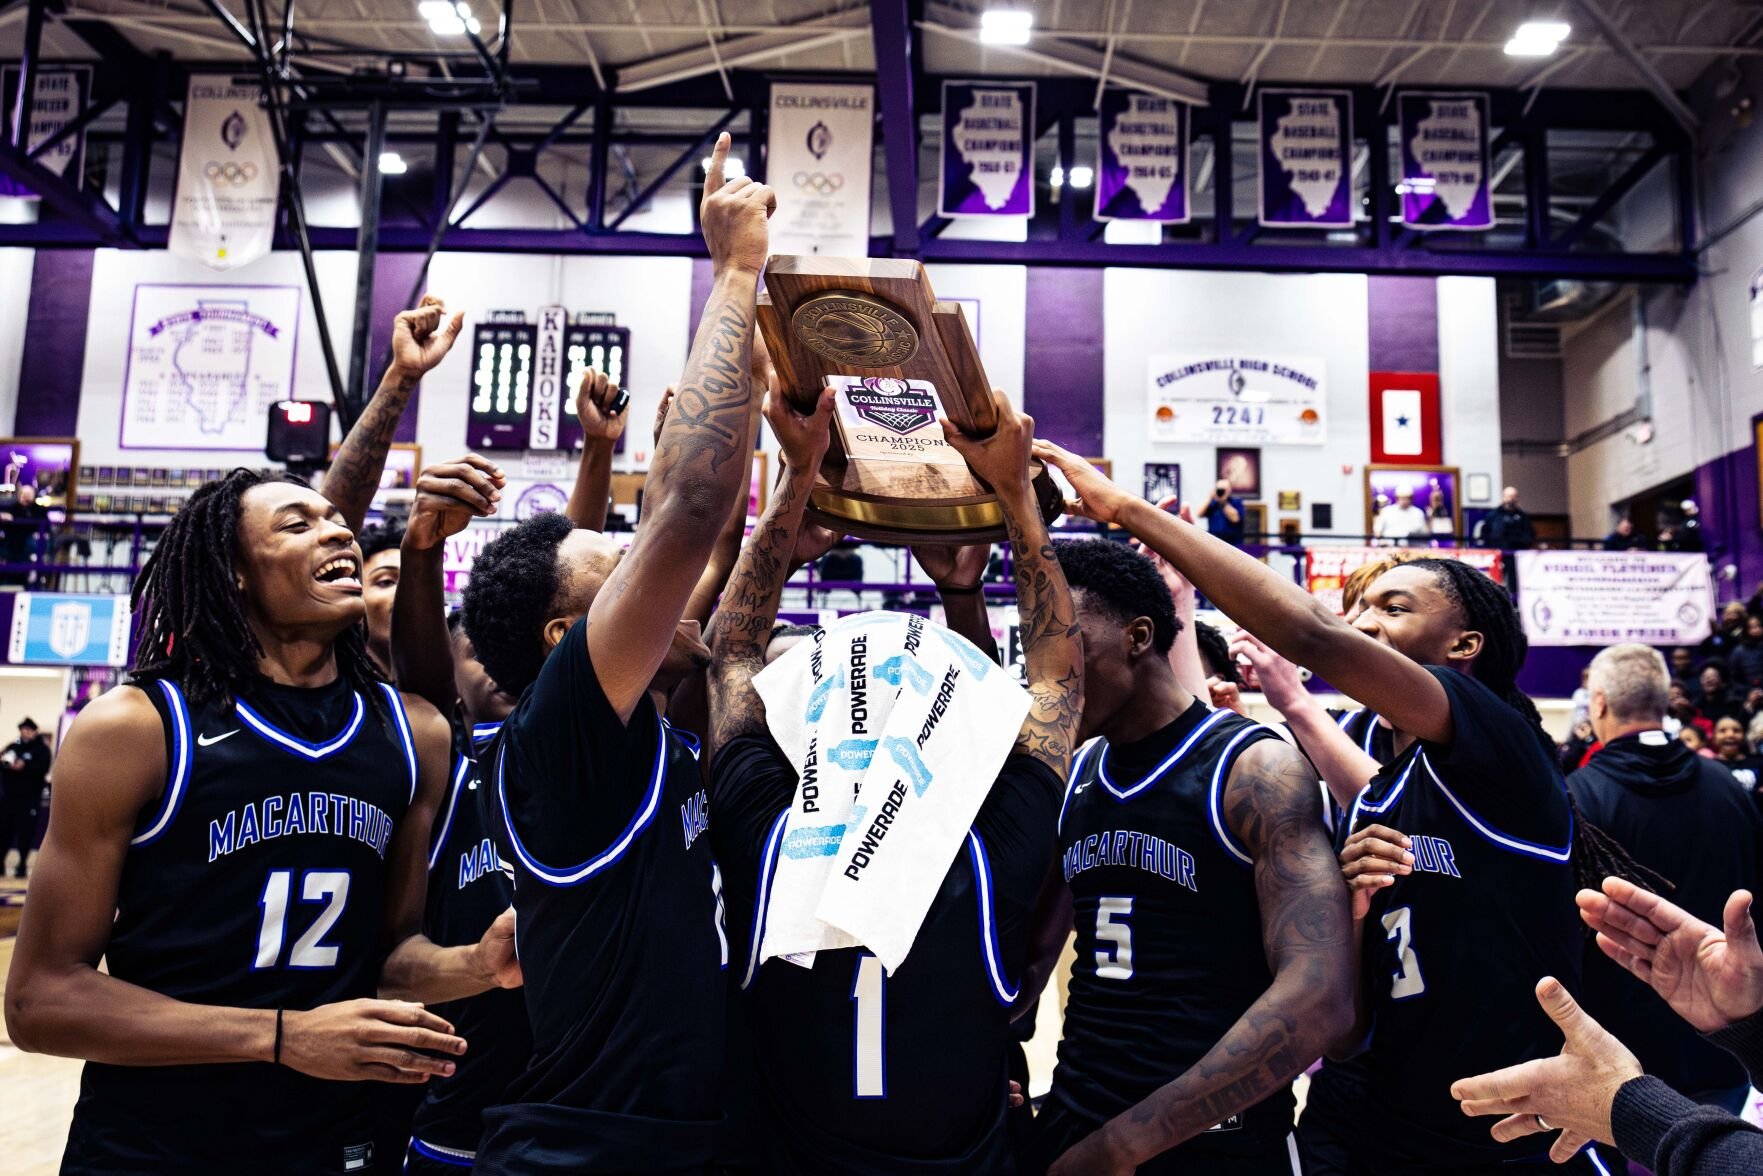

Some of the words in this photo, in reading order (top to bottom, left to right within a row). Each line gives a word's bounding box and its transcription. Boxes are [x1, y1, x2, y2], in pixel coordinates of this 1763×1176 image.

[776, 95, 866, 108] COLLINSVILLE
[981, 95, 1011, 107] STATE
[1137, 99, 1167, 112] STATE
[1298, 103, 1328, 115] STATE
[1437, 106, 1468, 118] STATE
[963, 118, 1019, 130] BASKETBALL
[1120, 124, 1174, 135] BASKETBALL
[1283, 126, 1336, 138] BASEBALL
[1423, 128, 1475, 140] BASEBALL
[963, 139, 1021, 151] CHAMPIONS
[1120, 144, 1178, 156] CHAMPIONS
[1283, 148, 1341, 159] CHAMPIONS
[1422, 150, 1479, 162] CHAMPIONS
[804, 302, 899, 327] COLLINSVILLE
[537, 312, 558, 444] KAHOKS
[1156, 359, 1235, 388] COLLINSVILLE
[1239, 359, 1269, 372] HIGH
[1273, 364, 1318, 391] SCHOOL
[850, 394, 933, 408] COLLINSVILLE
[869, 405, 896, 413] Holiday
[890, 443, 925, 452] 2025
[851, 634, 867, 735] POWERADE
[916, 664, 960, 751] POWERADE
[208, 791, 394, 862] MACARTHUR
[844, 779, 909, 881] POWERADE
[788, 836, 842, 850] POWERADE
[251, 869, 351, 970] 12
[1094, 895, 1136, 981] 5
[1380, 904, 1426, 1000] 3
[850, 953, 886, 1098] 1
